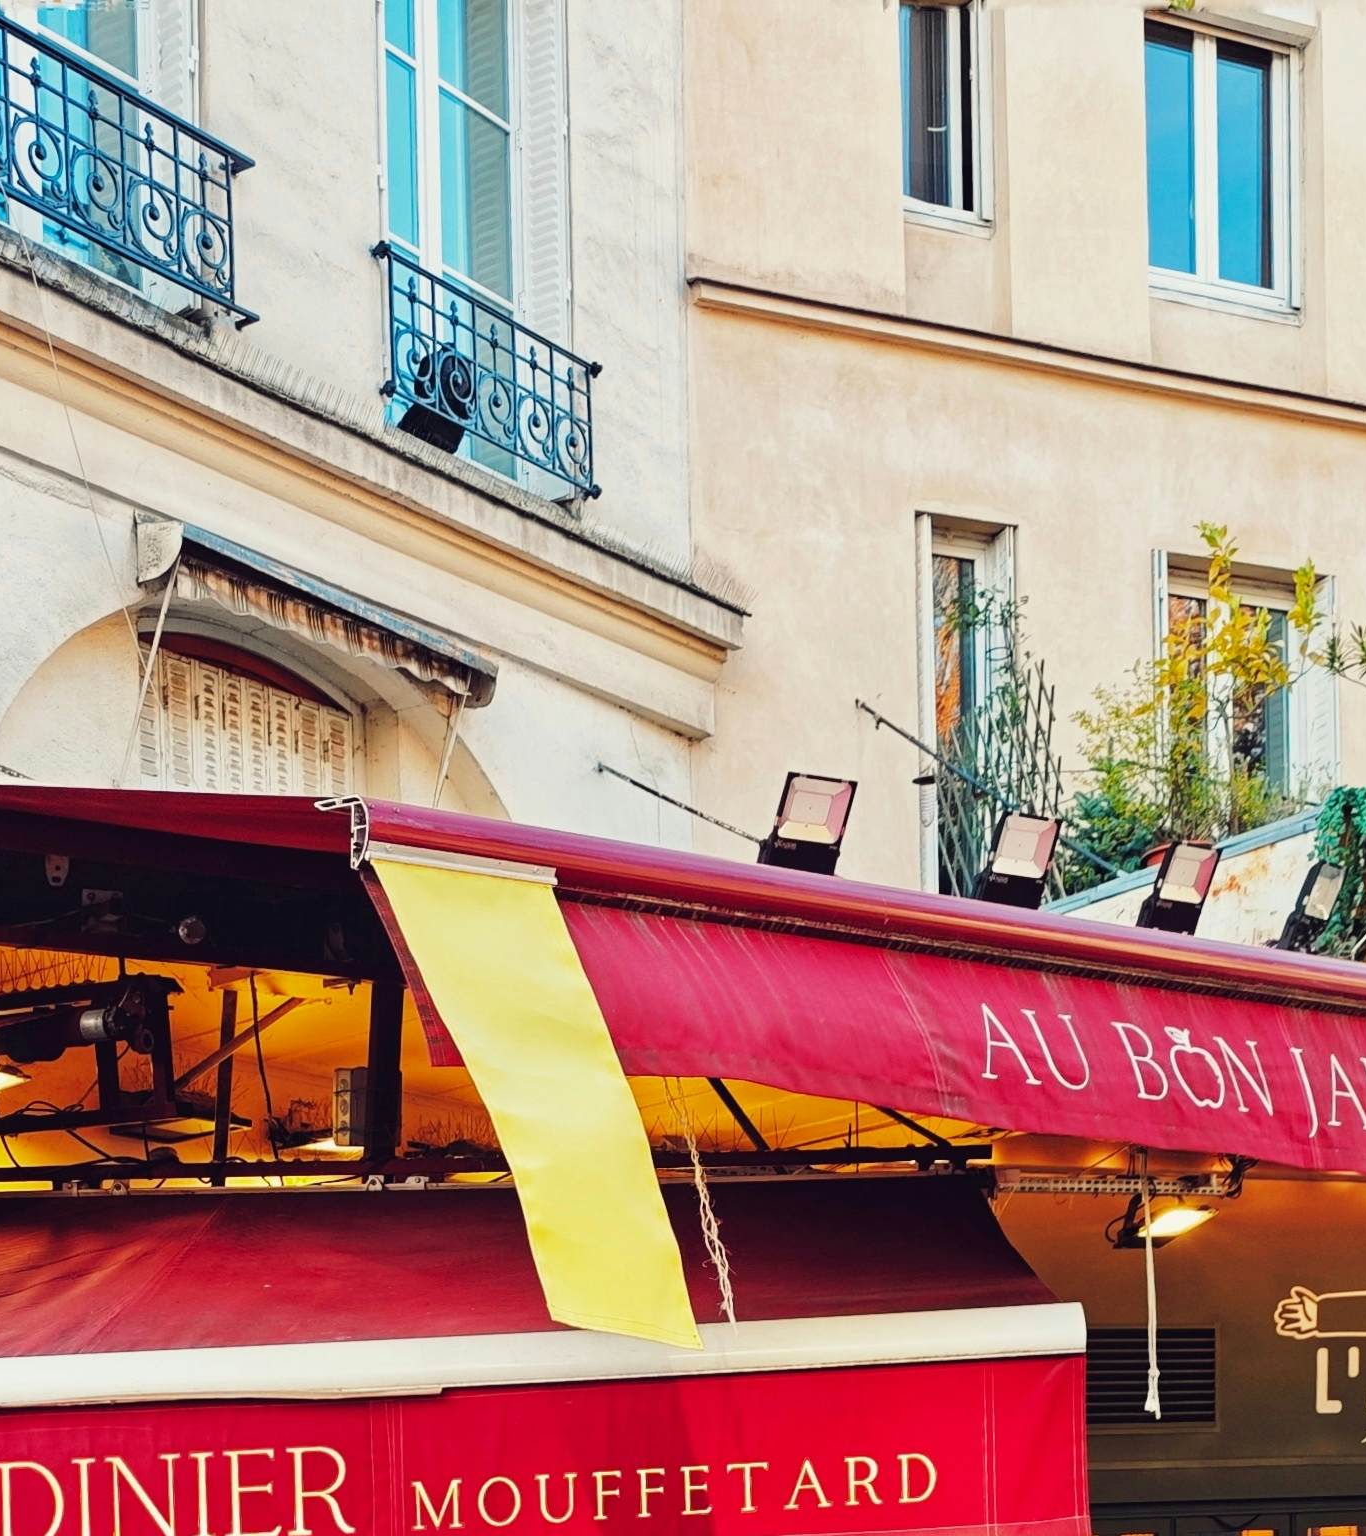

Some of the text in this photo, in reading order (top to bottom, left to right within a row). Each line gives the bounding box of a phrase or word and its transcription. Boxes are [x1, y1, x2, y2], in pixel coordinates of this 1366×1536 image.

[981, 1002, 1091, 1091] AU
[1111, 1021, 1275, 1115] BON
[411, 1451, 938, 1532] MOUFFETARD
